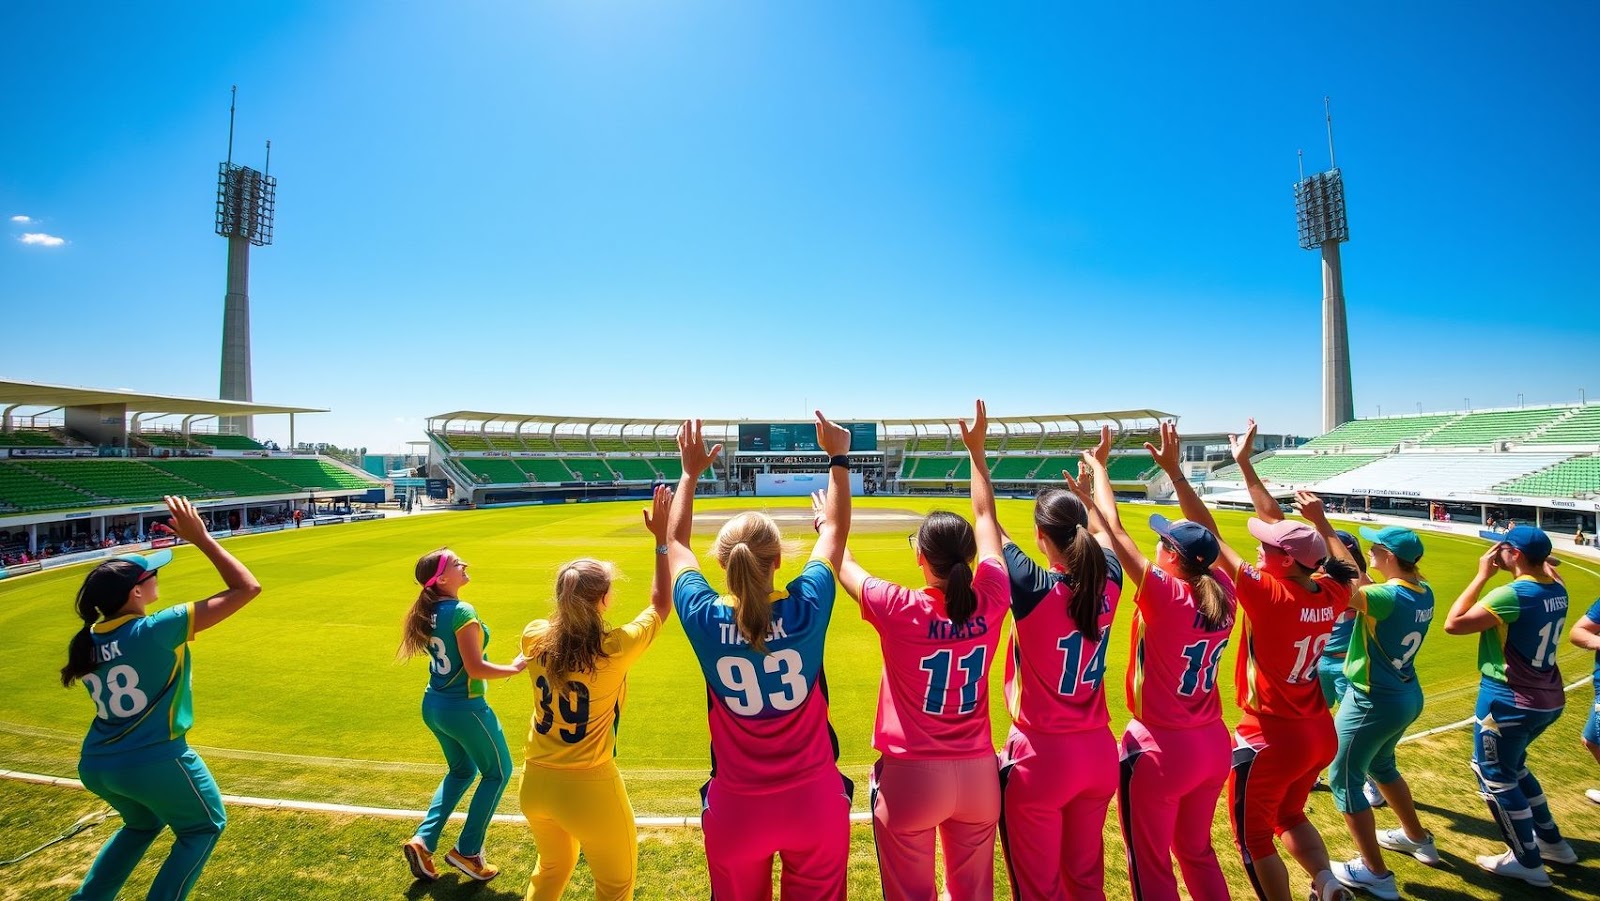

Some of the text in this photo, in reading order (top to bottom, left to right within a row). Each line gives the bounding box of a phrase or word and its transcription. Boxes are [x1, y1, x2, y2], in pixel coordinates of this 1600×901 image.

[534, 675, 590, 744] 39
[716, 648, 809, 716] 93
[919, 645, 987, 715] 11
